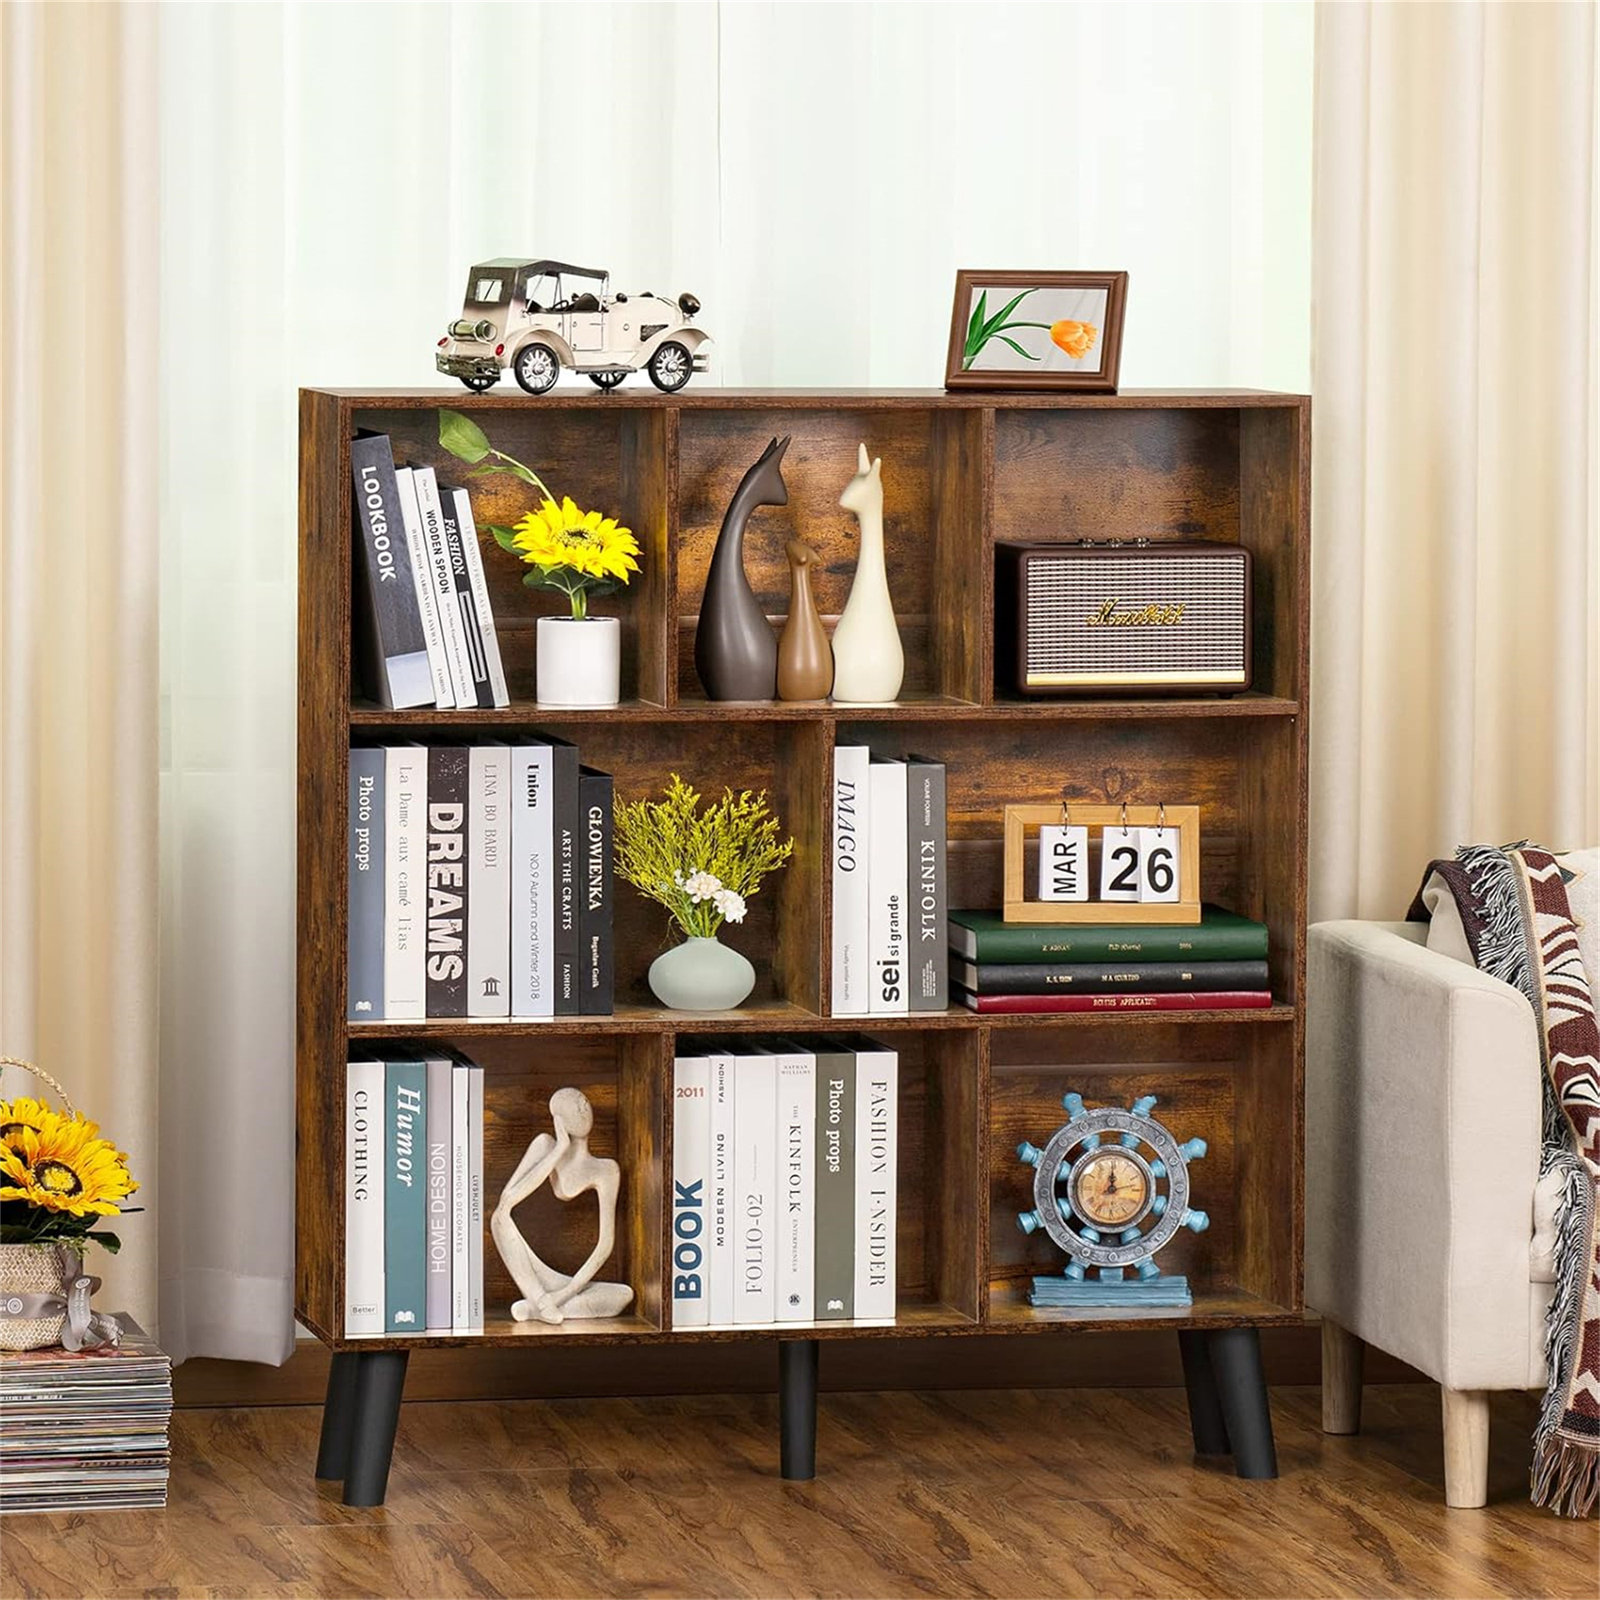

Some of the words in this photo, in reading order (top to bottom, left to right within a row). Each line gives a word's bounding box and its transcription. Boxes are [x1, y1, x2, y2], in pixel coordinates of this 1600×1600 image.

[361, 466, 396, 581] LOOKBOOK
[426, 509, 443, 555] WOODEN
[436, 559, 450, 594] SPOON
[444, 518, 465, 576] FASHION
[399, 766, 413, 783] La
[485, 764, 497, 796] LINA
[528, 764, 540, 807] Union
[358, 776, 373, 821] Photo
[398, 793, 413, 827] Dame
[485, 805, 497, 822] BO
[562, 830, 571, 858] ARTS
[837, 779, 856, 873] IMAGO
[355, 828, 371, 871] props
[398, 836, 410, 862] aux
[485, 829, 497, 869] BARDI
[588, 806, 602, 910] GŁOWIENKA
[1052, 841, 1078, 895] MAR
[1108, 846, 1173, 893] 26
[398, 872, 413, 906] camé
[428, 803, 464, 981] DREAMS
[563, 861, 572, 883] THE
[921, 840, 936, 942] KINFOLK
[530, 880, 540, 919] Autumn
[563, 886, 572, 930] CRAFTS
[884, 895, 900, 942] grande
[398, 917, 413, 950] lias
[530, 920, 540, 941] and
[887, 945, 899, 956] si
[530, 943, 540, 972] Winter
[530, 975, 540, 1000] 2018
[563, 963, 571, 999] FASHION
[877, 959, 900, 1002] sei
[677, 1087, 704, 1098] 2011
[829, 1079, 843, 1123] Photo
[354, 1091, 367, 1201] CLOTHING
[396, 1085, 420, 1187] Humor
[871, 1081, 886, 1173] FASHION
[789, 1125, 801, 1213] KINFOLK
[826, 1130, 840, 1172] props
[431, 1218, 446, 1273] HOME
[674, 1180, 703, 1299] BOOK
[746, 1194, 763, 1294] FOLIO-02
